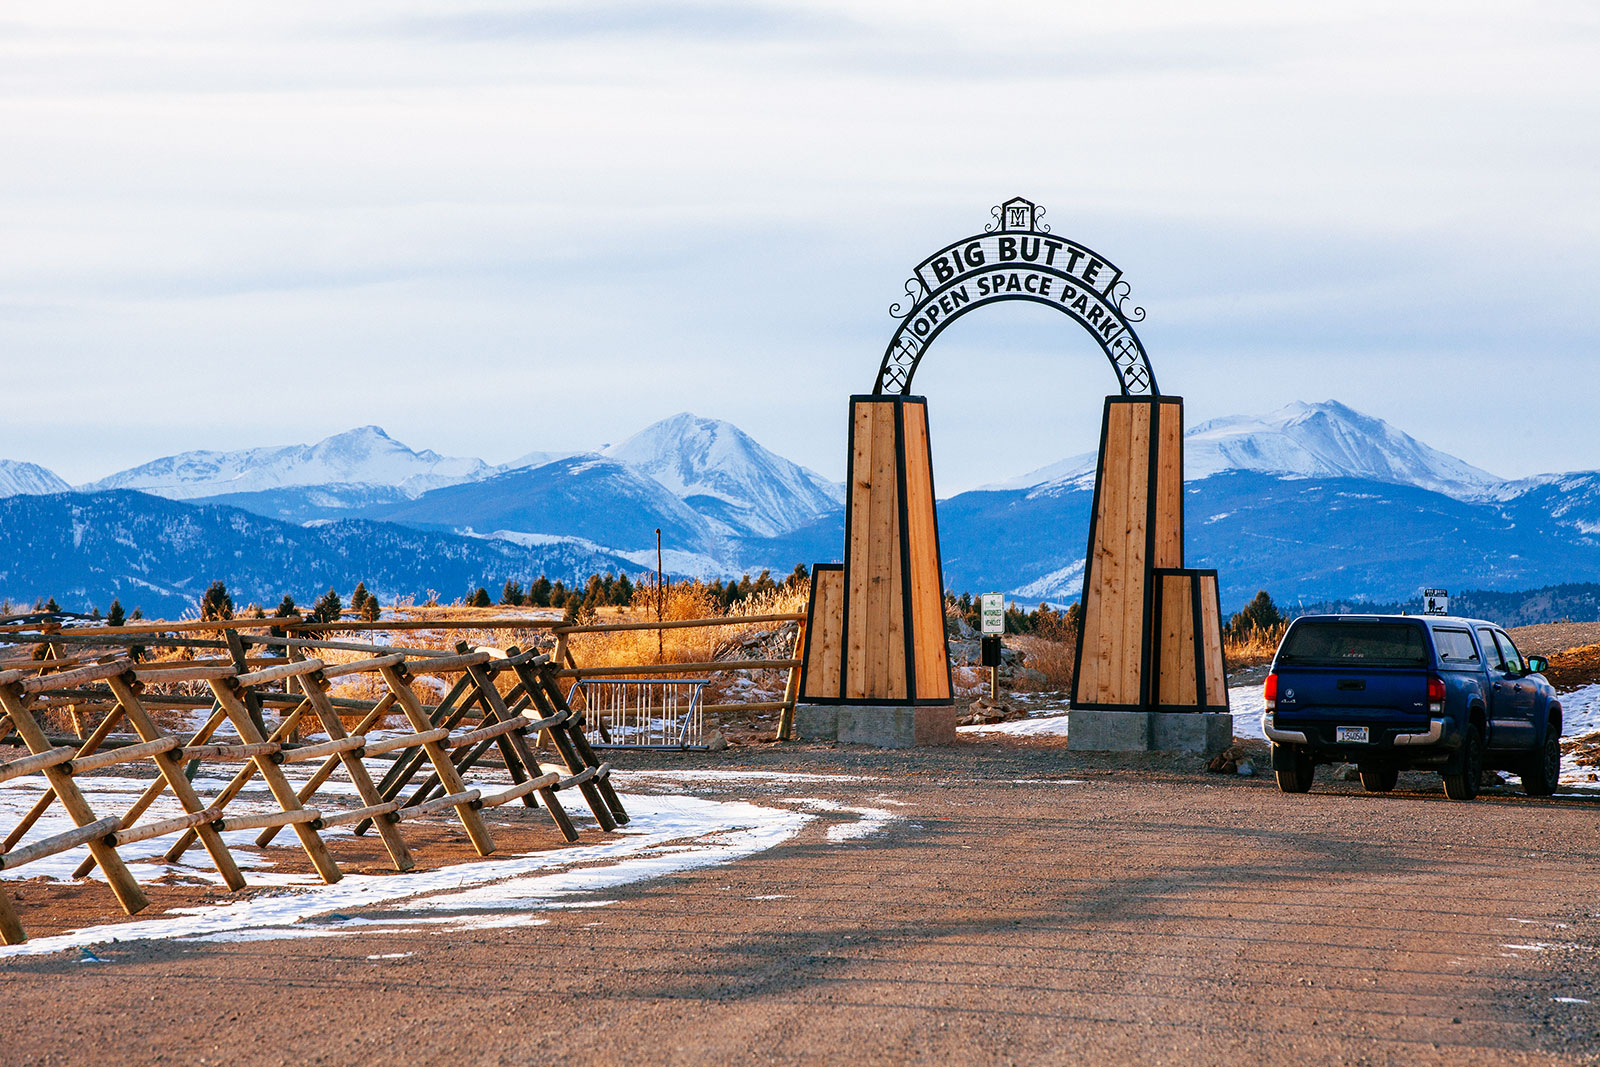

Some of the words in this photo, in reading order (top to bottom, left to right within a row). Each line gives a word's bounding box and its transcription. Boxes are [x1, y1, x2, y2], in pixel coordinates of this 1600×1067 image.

[930, 241, 985, 284] BIG
[998, 237, 1104, 286] BUTTE
[913, 285, 970, 337] OPEN
[976, 273, 1053, 297] SPACE
[1060, 285, 1118, 339] PARK
